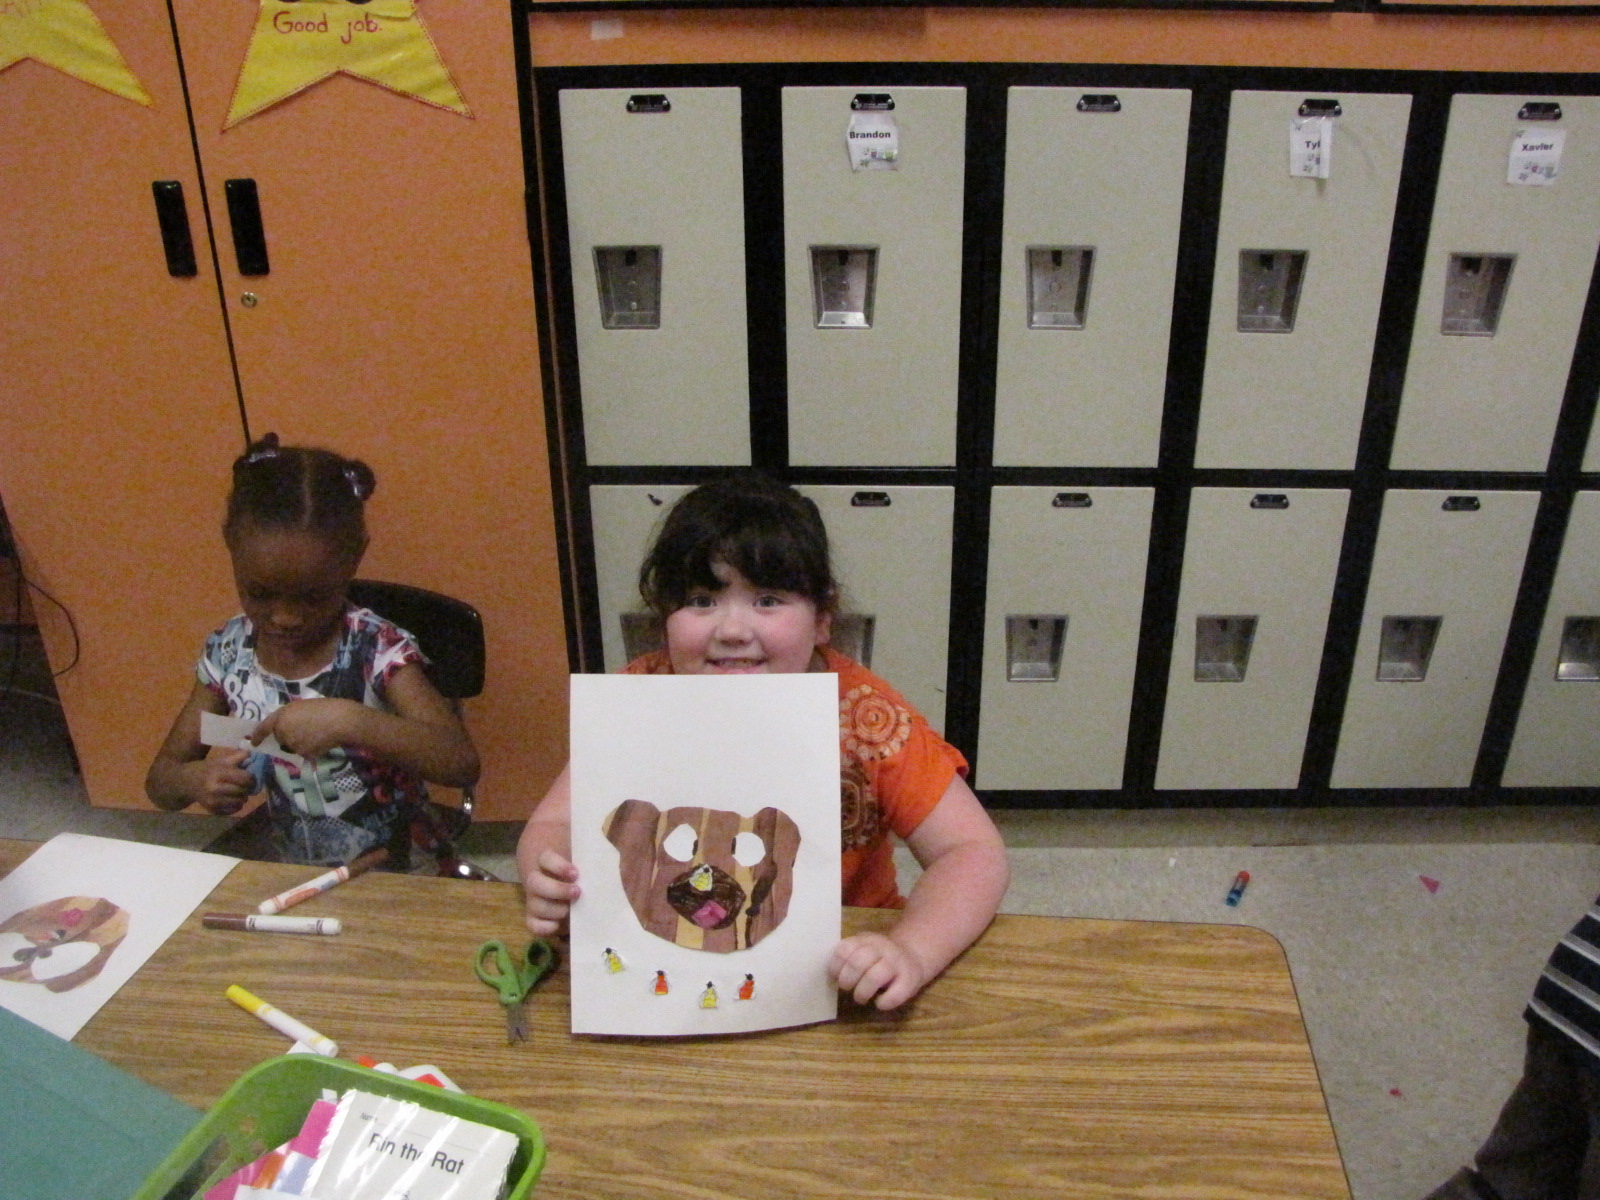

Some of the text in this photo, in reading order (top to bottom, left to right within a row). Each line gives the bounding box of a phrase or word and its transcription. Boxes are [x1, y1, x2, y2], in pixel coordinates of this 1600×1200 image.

[273, 11, 328, 34] Good
[849, 130, 891, 139] Brandon
[1522, 143, 1554, 152] Xavier
[431, 1151, 464, 1175] Rat
